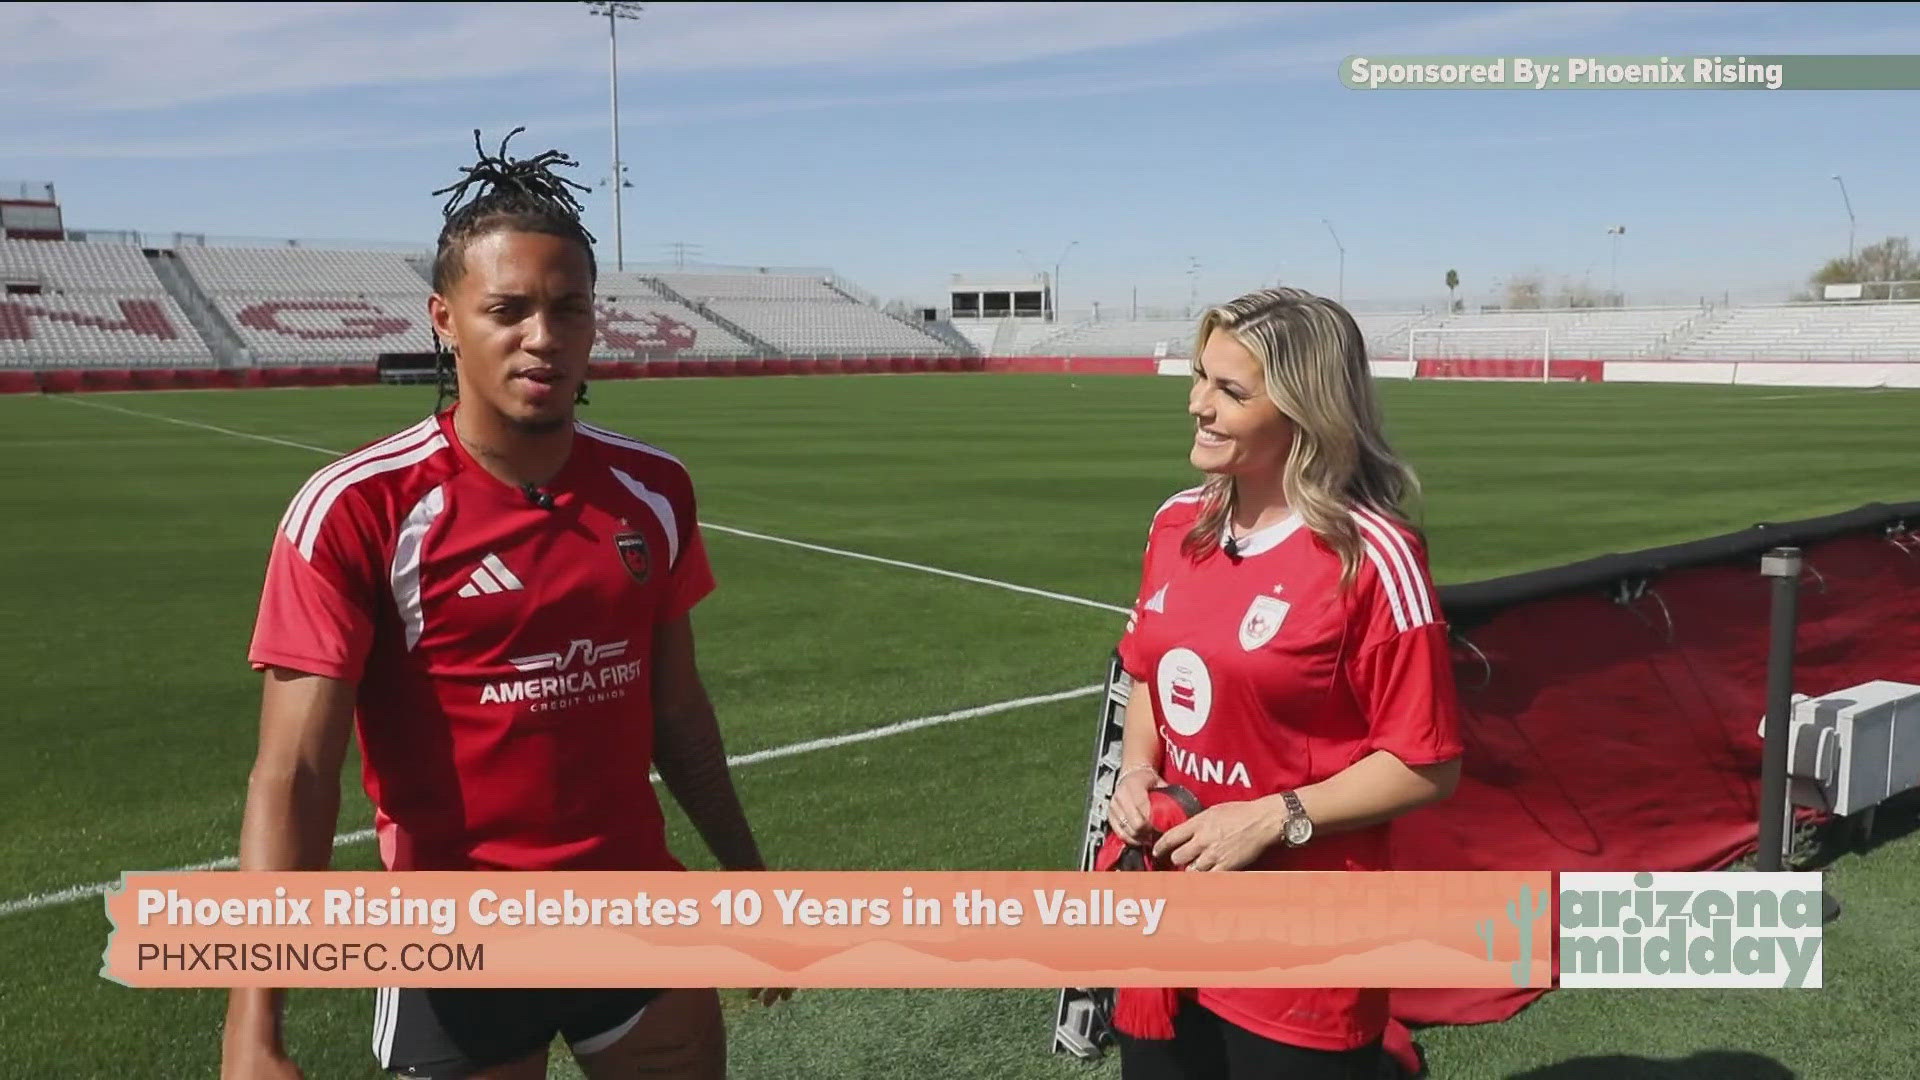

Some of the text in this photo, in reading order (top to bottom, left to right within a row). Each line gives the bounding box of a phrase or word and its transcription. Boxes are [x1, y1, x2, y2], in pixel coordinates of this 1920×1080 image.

[480, 658, 641, 705] AMERICA FIRST
[530, 690, 626, 713] CREDIT UNION
